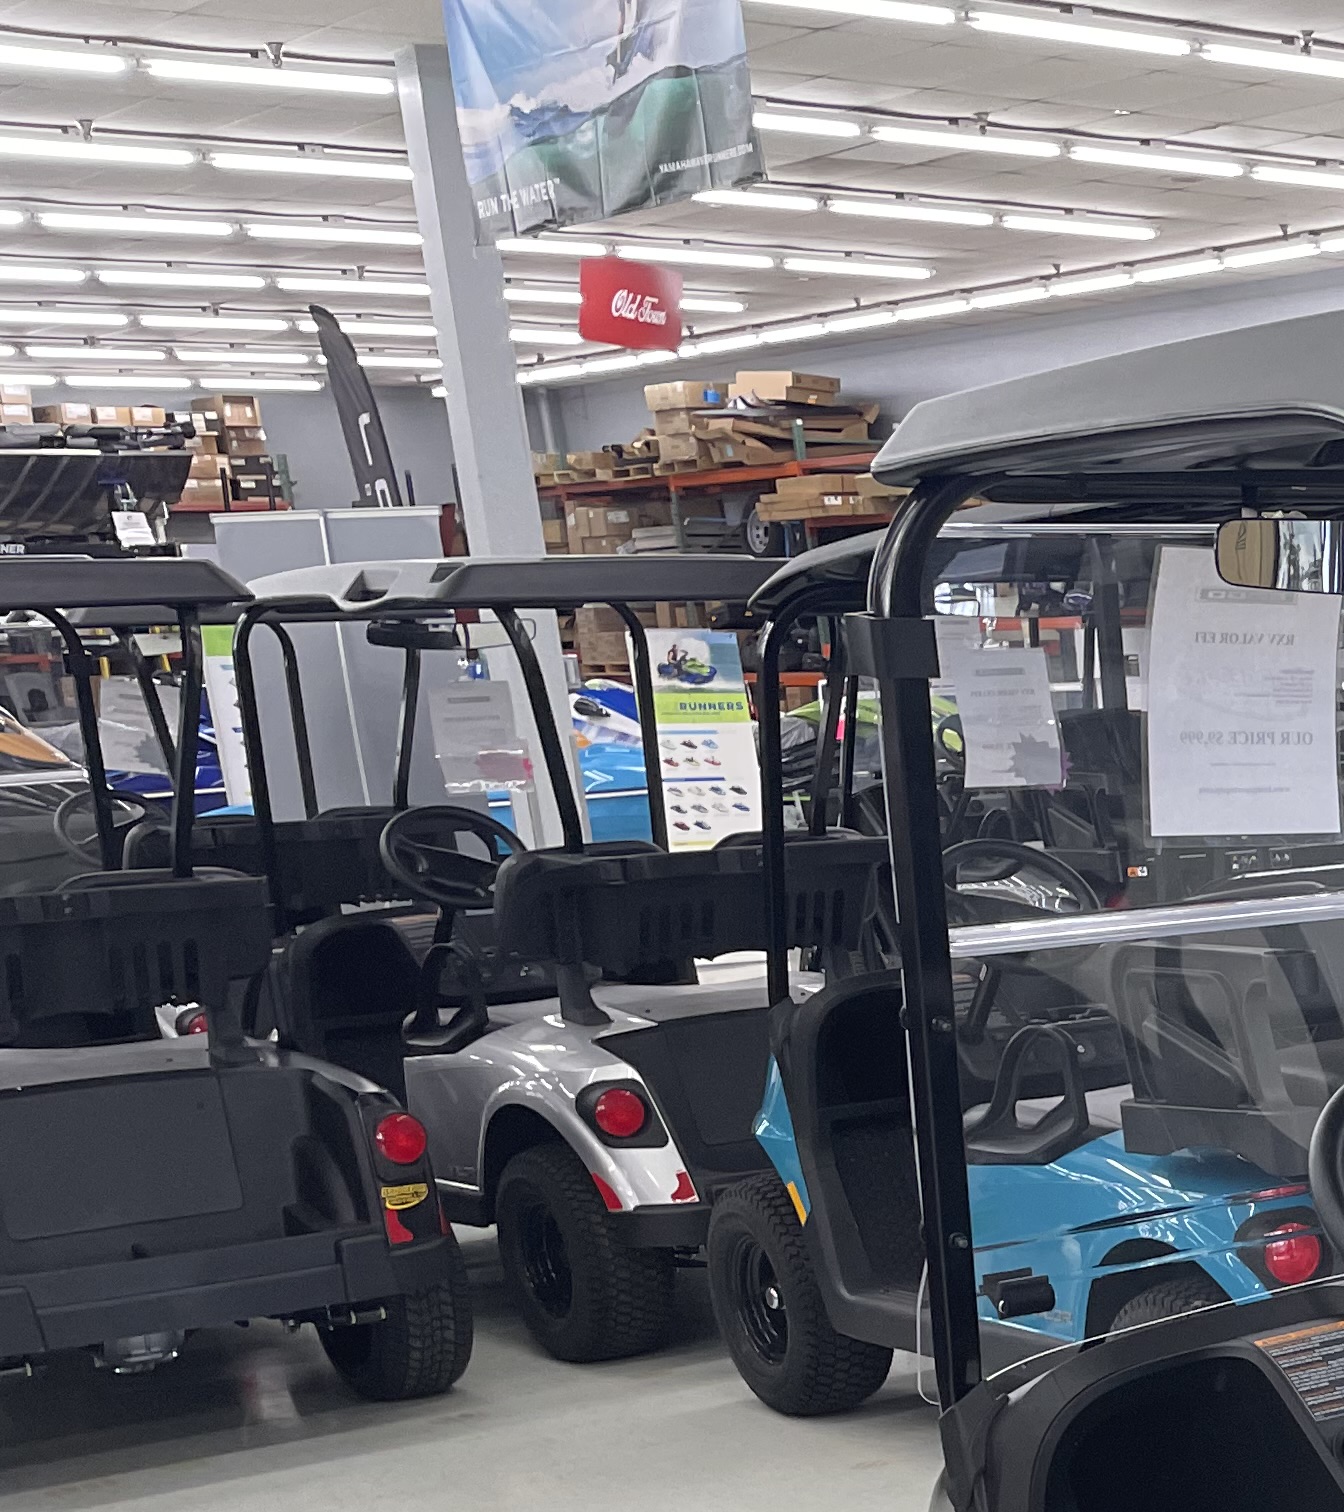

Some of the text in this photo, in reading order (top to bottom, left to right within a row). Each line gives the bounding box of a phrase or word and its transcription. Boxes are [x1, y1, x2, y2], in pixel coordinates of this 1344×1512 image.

[477, 197, 499, 219] RUN
[500, 190, 520, 213] THE
[611, 289, 667, 325] Old Town
